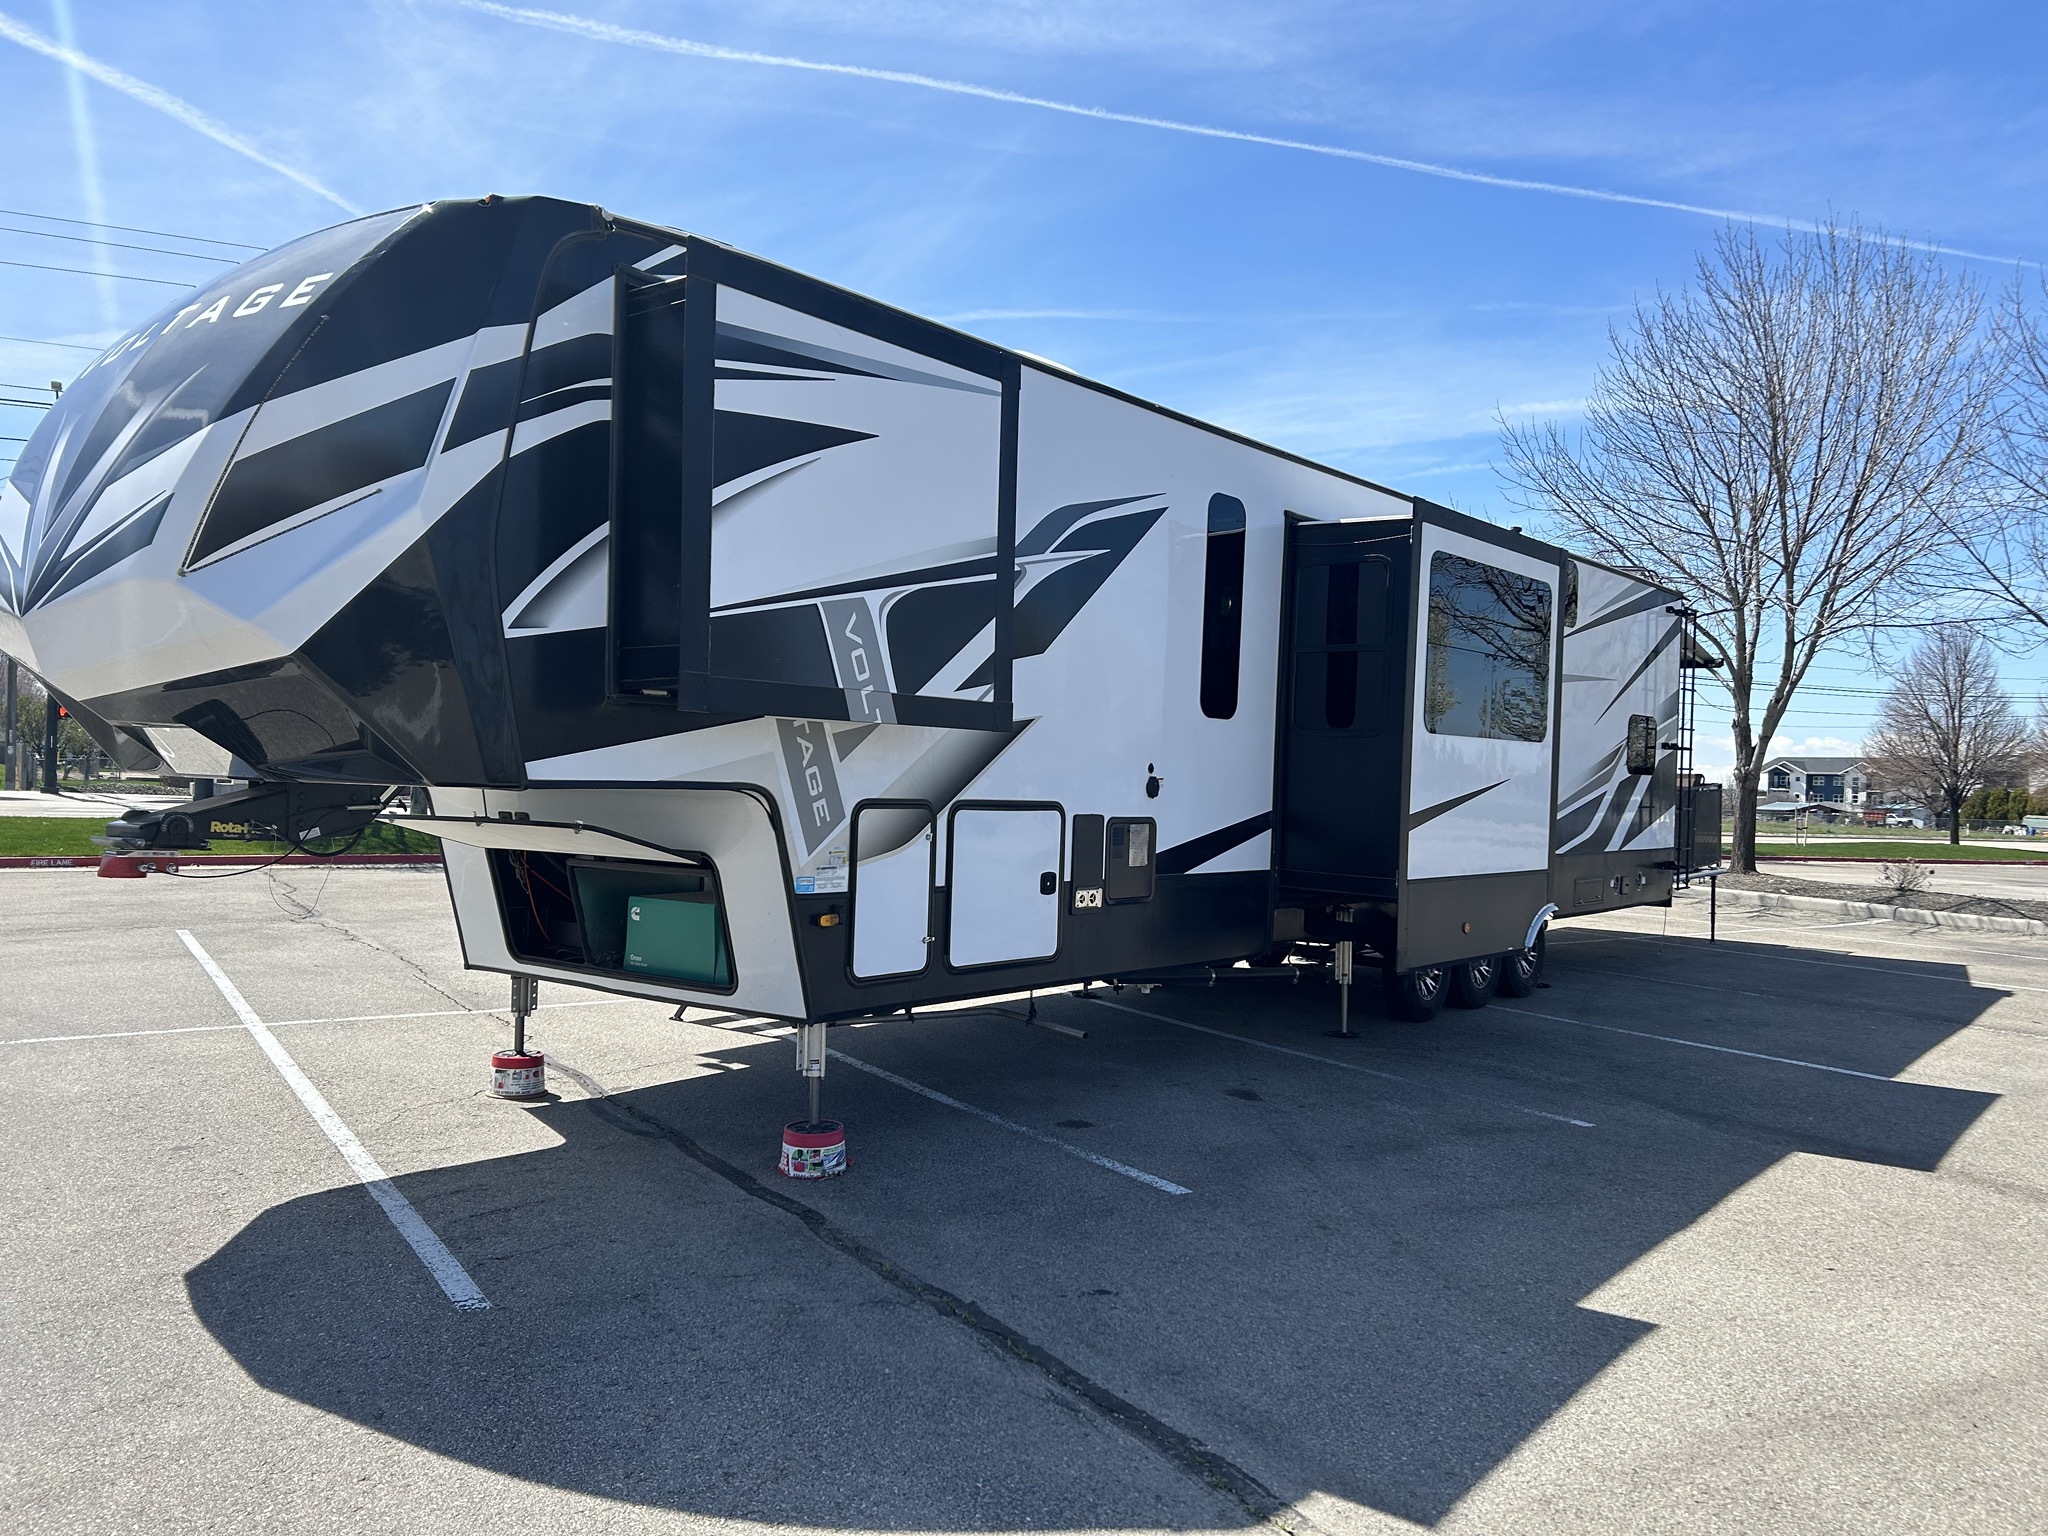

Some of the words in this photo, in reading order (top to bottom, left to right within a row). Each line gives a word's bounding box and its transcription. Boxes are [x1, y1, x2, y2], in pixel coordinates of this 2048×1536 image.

[80, 271, 335, 380] VOLTAGE
[30, 859, 49, 867] FIRE
[50, 858, 74, 866] LANE
